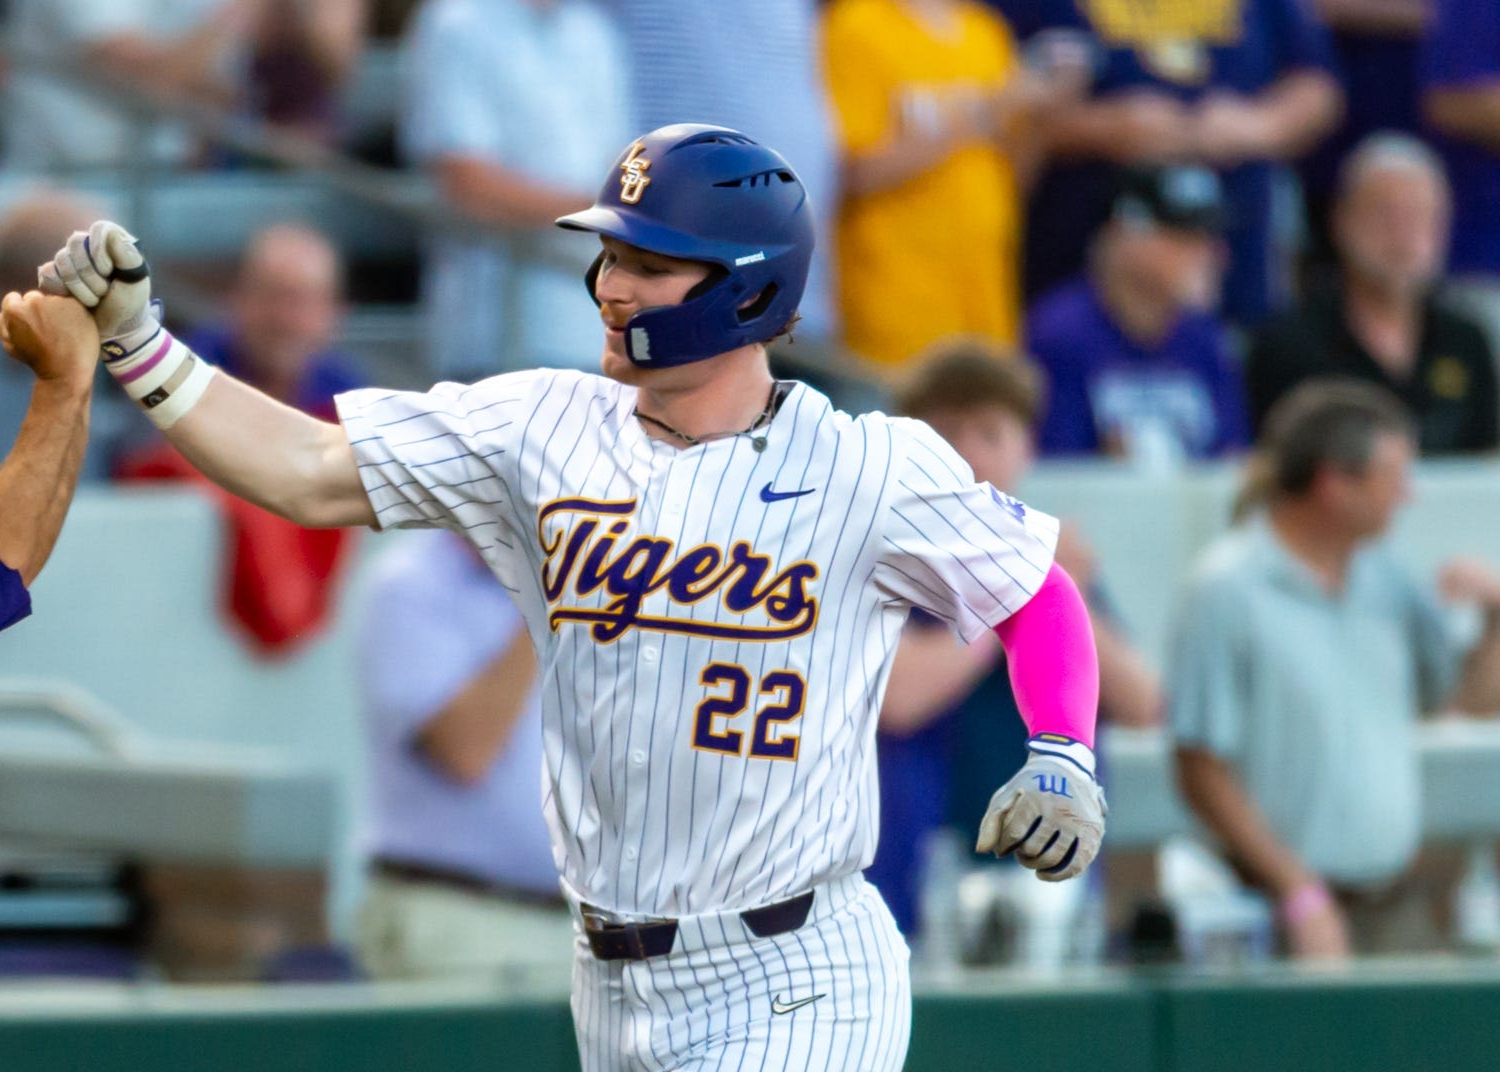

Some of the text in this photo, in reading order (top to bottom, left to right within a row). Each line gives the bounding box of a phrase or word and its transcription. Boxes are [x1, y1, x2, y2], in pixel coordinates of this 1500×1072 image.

[620, 141, 651, 204] LSU
[538, 497, 819, 644] Tigers
[691, 662, 807, 761] 22
